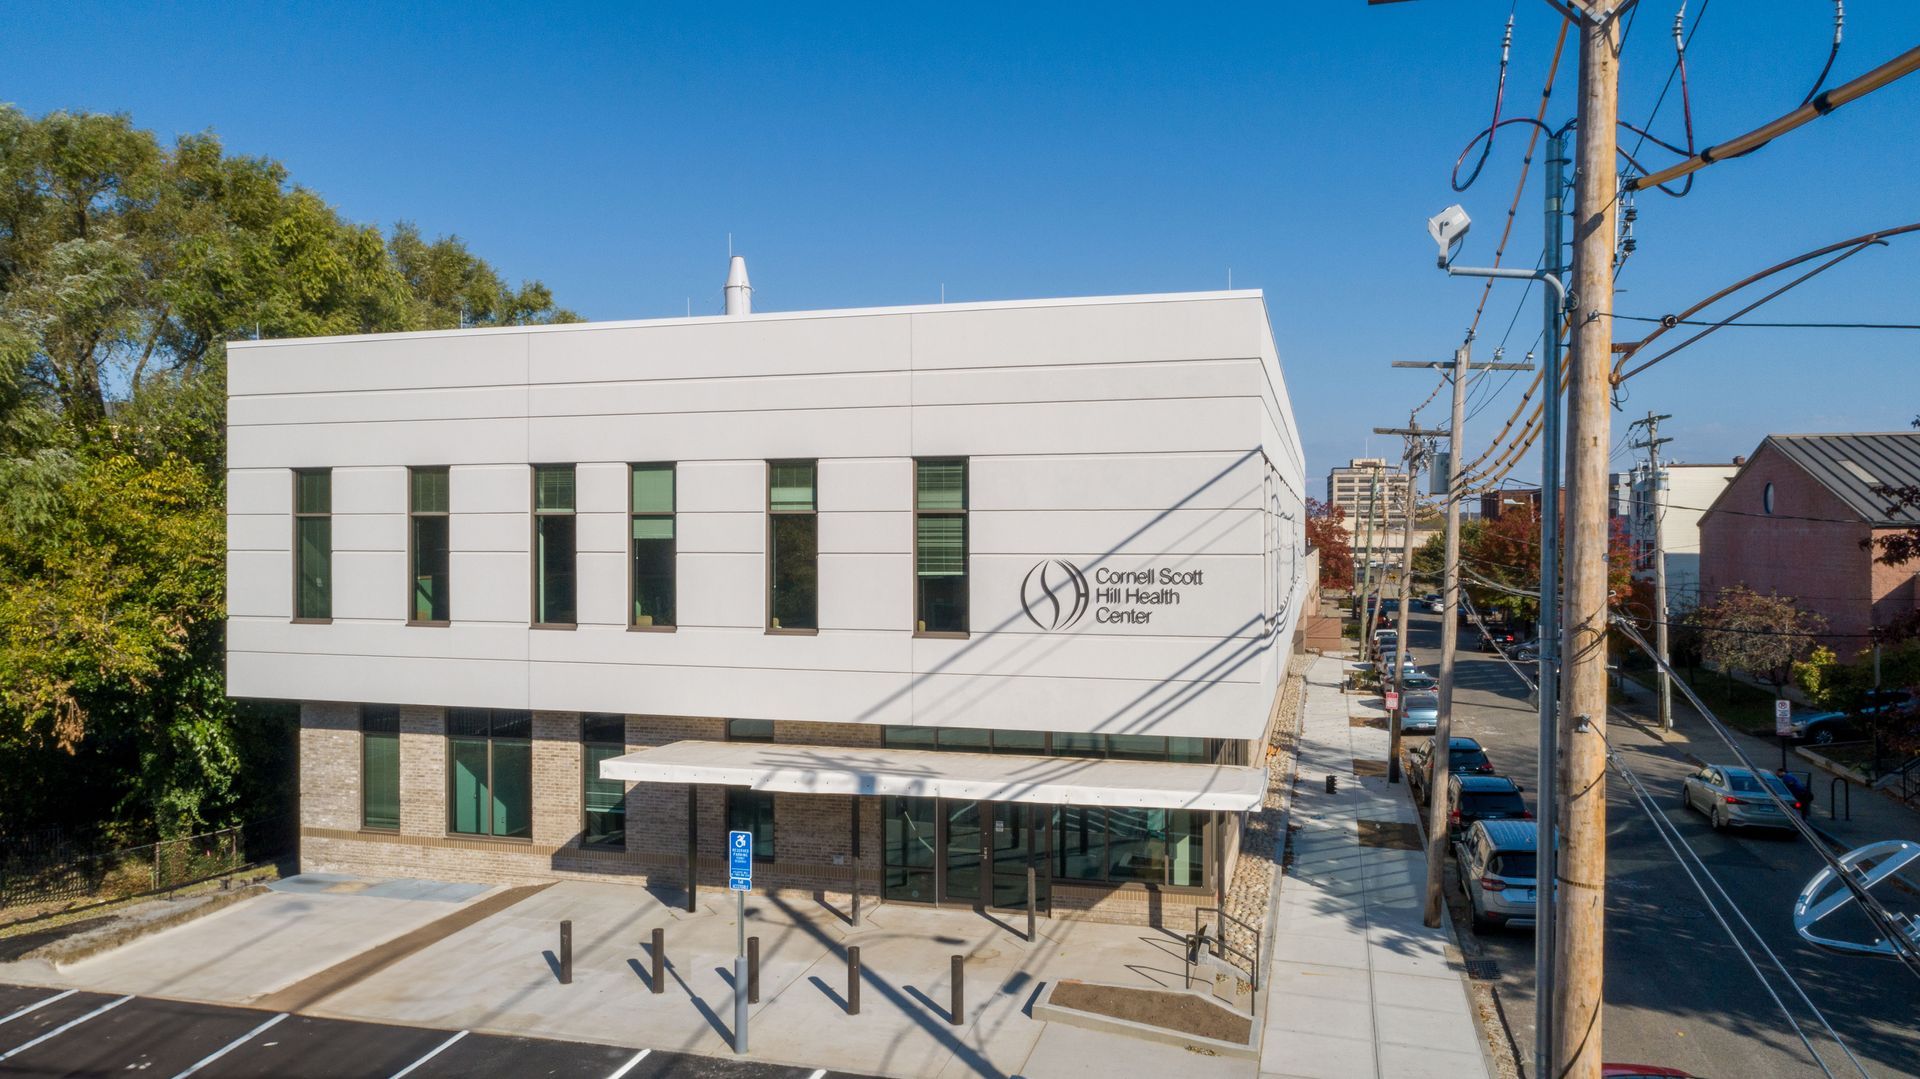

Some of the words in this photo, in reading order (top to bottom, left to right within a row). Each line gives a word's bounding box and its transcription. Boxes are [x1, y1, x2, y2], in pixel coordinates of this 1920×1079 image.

[1096, 567, 1155, 585] Cornell
[1158, 568, 1204, 586] Scott
[1096, 588, 1122, 605] Hill
[1126, 588, 1180, 605] Health
[1096, 606, 1153, 624] Center
